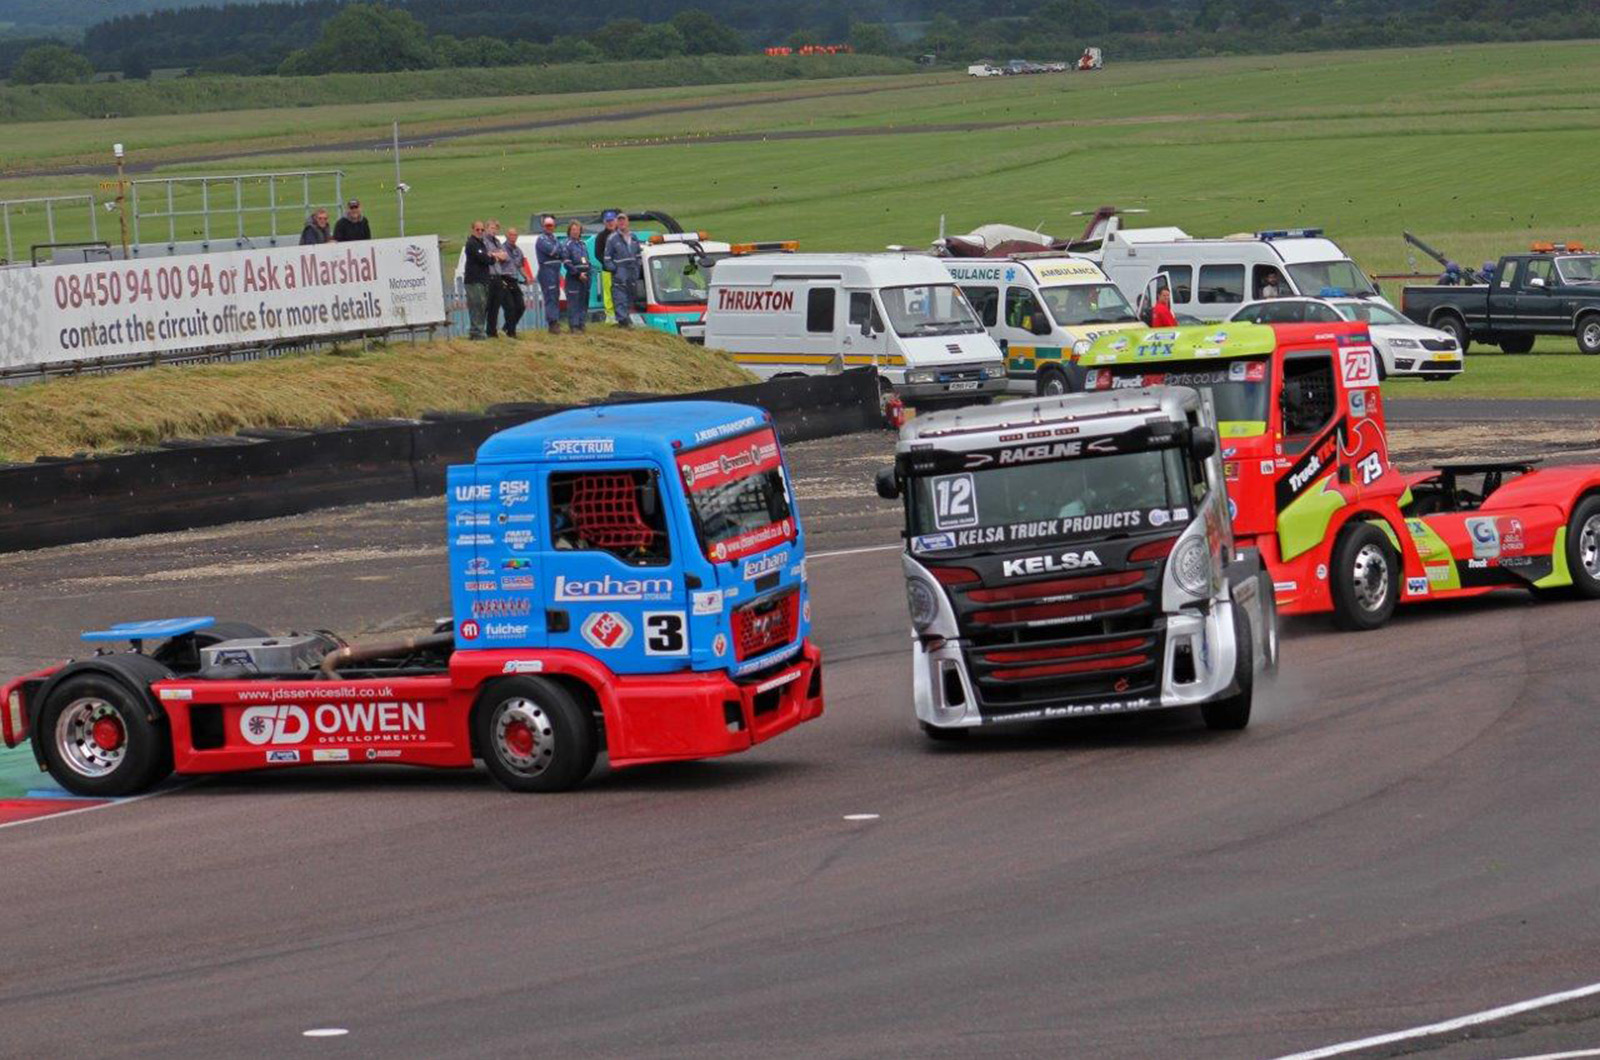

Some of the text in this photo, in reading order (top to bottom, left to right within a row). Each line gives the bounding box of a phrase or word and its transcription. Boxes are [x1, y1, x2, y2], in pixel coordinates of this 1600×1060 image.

[54, 246, 378, 309] 08450 94 00 94 or Ask a Marshal
[389, 276, 427, 289] Motorsport
[948, 268, 1000, 280] BULANCE
[1040, 267, 1099, 278] AMBULANCE
[718, 289, 794, 310] THRUXTON
[60, 291, 382, 349] contact the circuit office for more details
[1137, 343, 1174, 357] TTX
[1345, 350, 1371, 381] 79
[547, 439, 614, 456] SPECTRUM
[1000, 442, 1082, 464] RACELINE
[1357, 452, 1383, 485] 79
[937, 478, 971, 516] 12
[958, 526, 1005, 546] KELSA
[1010, 518, 1057, 541] TRUCK
[1063, 510, 1141, 531] PRODUCTS
[1003, 550, 1102, 577] KELSA
[554, 574, 673, 602] Lenham
[486, 622, 529, 635] fulcher
[647, 615, 683, 651] 3
[238, 686, 393, 701] www.jdsservicesltd.co.uk
[314, 702, 426, 734] OWEN
[319, 734, 426, 743] DEVELOPMENTS
